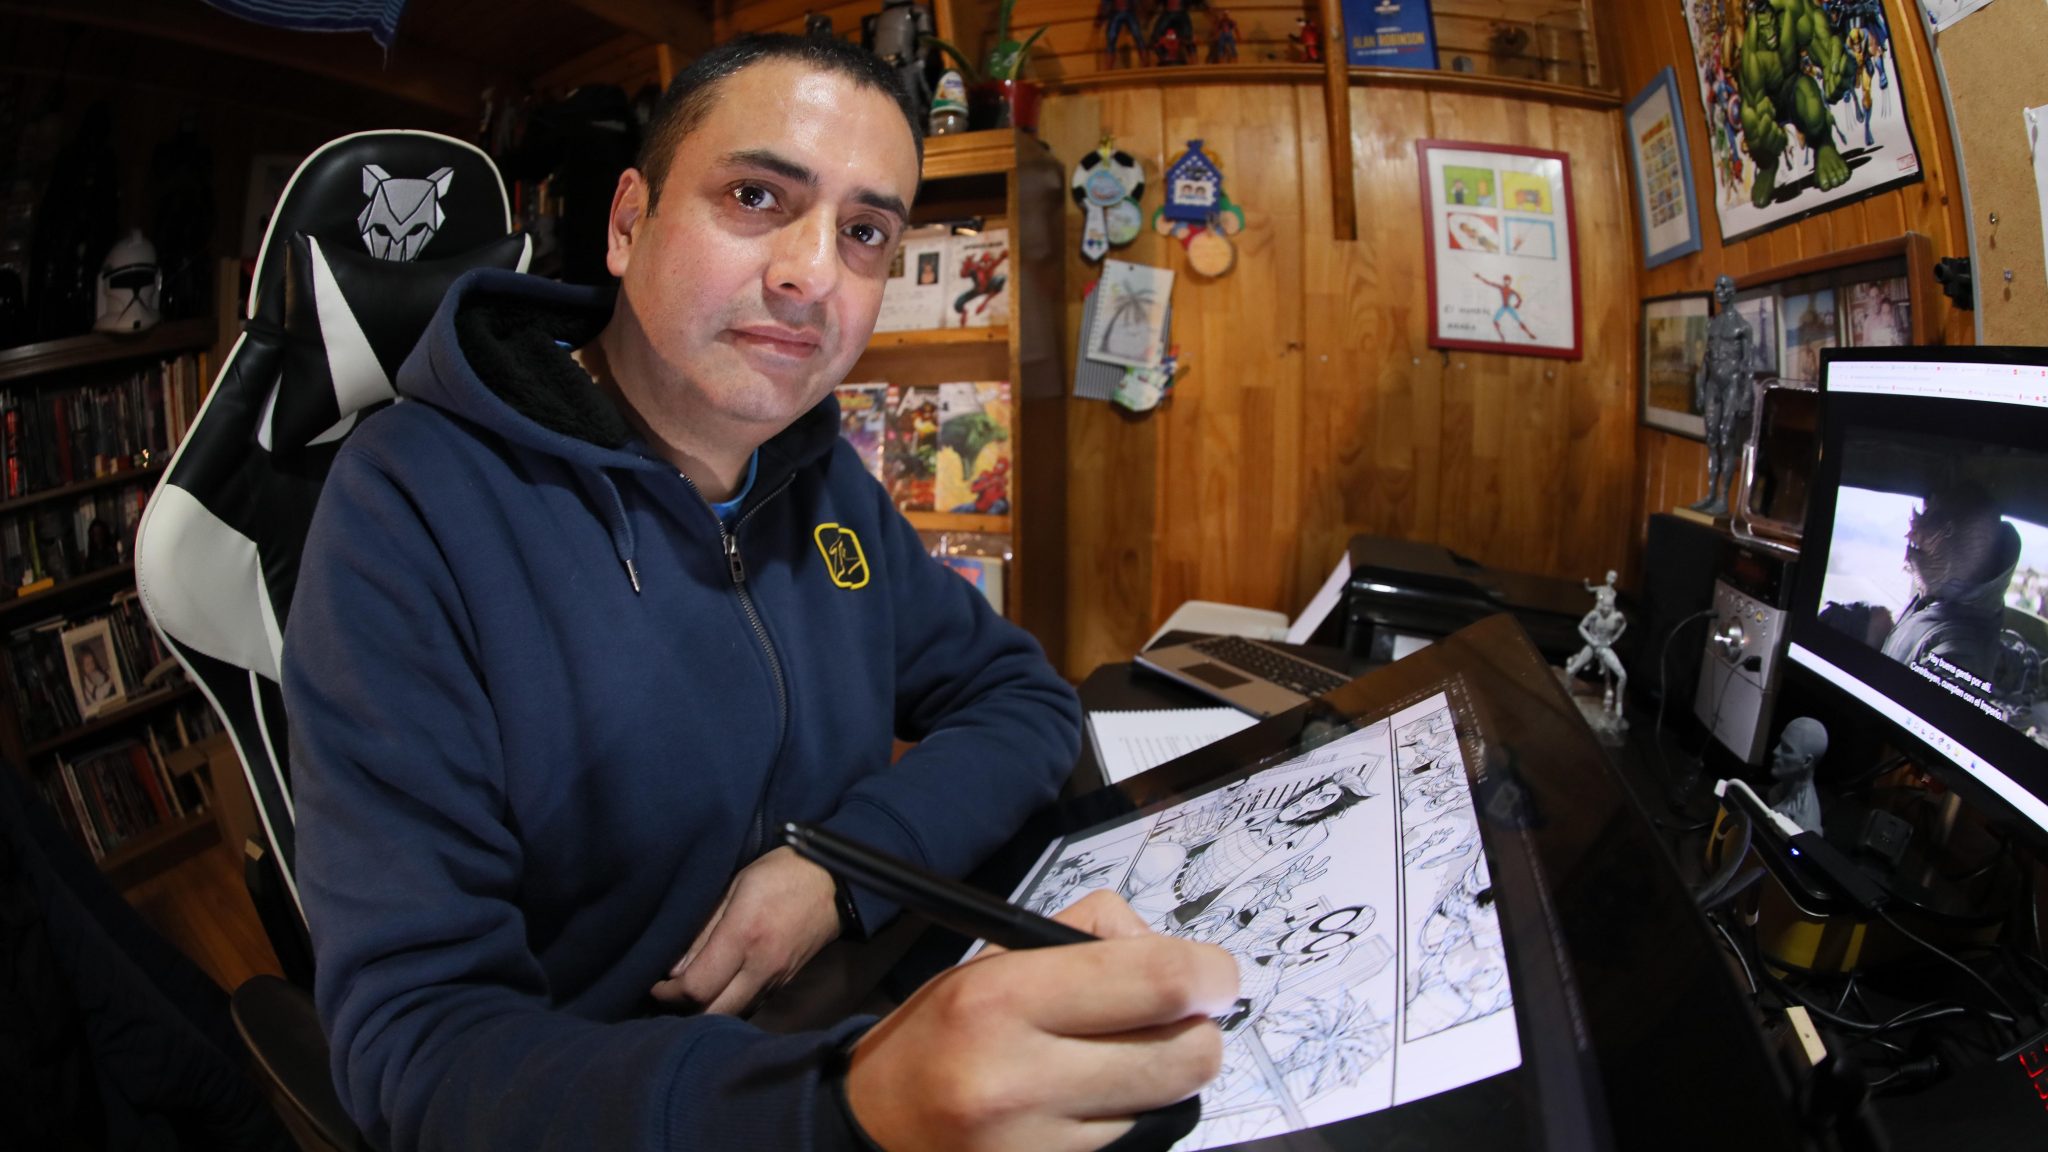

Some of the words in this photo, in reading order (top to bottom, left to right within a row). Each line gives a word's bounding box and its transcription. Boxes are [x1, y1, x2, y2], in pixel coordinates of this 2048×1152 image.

[1928, 652, 1940, 667] Hay
[1939, 658, 1957, 674] buena
[1955, 668, 1972, 682] gente
[1970, 676, 1982, 687] por
[1963, 692, 1975, 704] con
[1974, 698, 1982, 708] el
